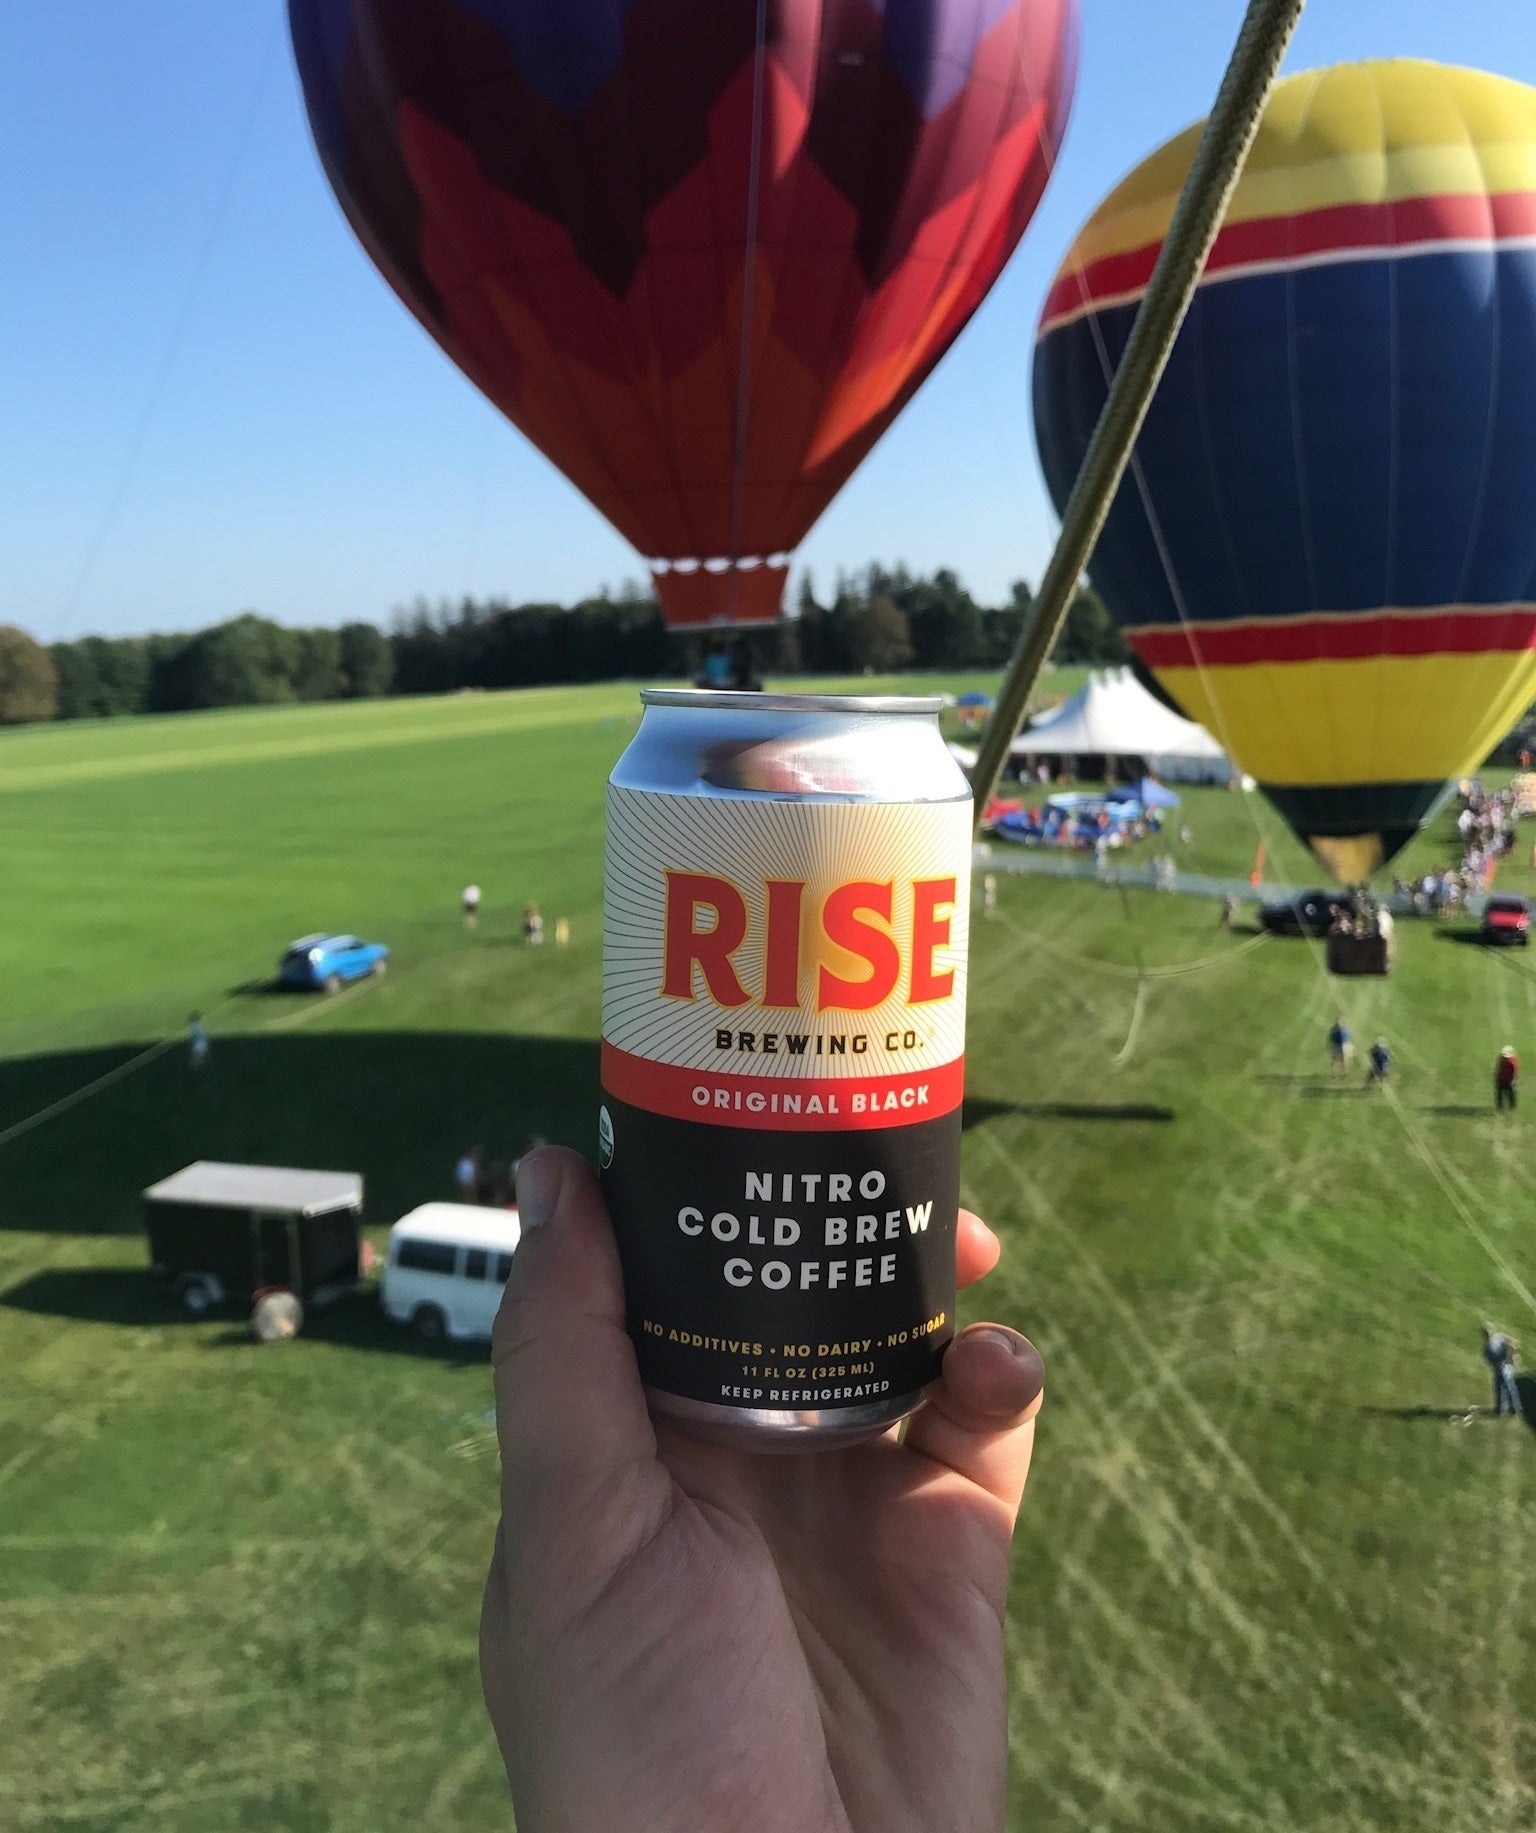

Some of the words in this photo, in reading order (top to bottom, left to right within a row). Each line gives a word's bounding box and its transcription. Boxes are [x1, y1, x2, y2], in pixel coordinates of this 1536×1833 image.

[660, 869, 957, 1015] RISE
[716, 1029, 868, 1055] BREWING
[886, 1030, 924, 1051] CO.
[691, 1086, 839, 1114] ORIGINAL
[851, 1085, 930, 1113] BLACK
[745, 1170, 886, 1203] NITRO
[677, 1206, 801, 1247] COLD
[825, 1201, 933, 1246] BREW
[723, 1253, 897, 1290] COFFEE
[643, 1319, 664, 1337] NO
[668, 1328, 764, 1356] ADDITIVES
[783, 1344, 811, 1357] NO
[817, 1339, 872, 1357] DAIRY
[887, 1331, 908, 1347] NO
[912, 1312, 945, 1340] SUGAR
[742, 1365, 758, 1376] 11
[764, 1367, 780, 1378] FL
[785, 1368, 807, 1379] OZ
[812, 1366, 846, 1380] (325
[851, 1361, 875, 1375] ML)
[721, 1384, 764, 1400] KEEP
[769, 1380, 890, 1401] REFRIGERATED
